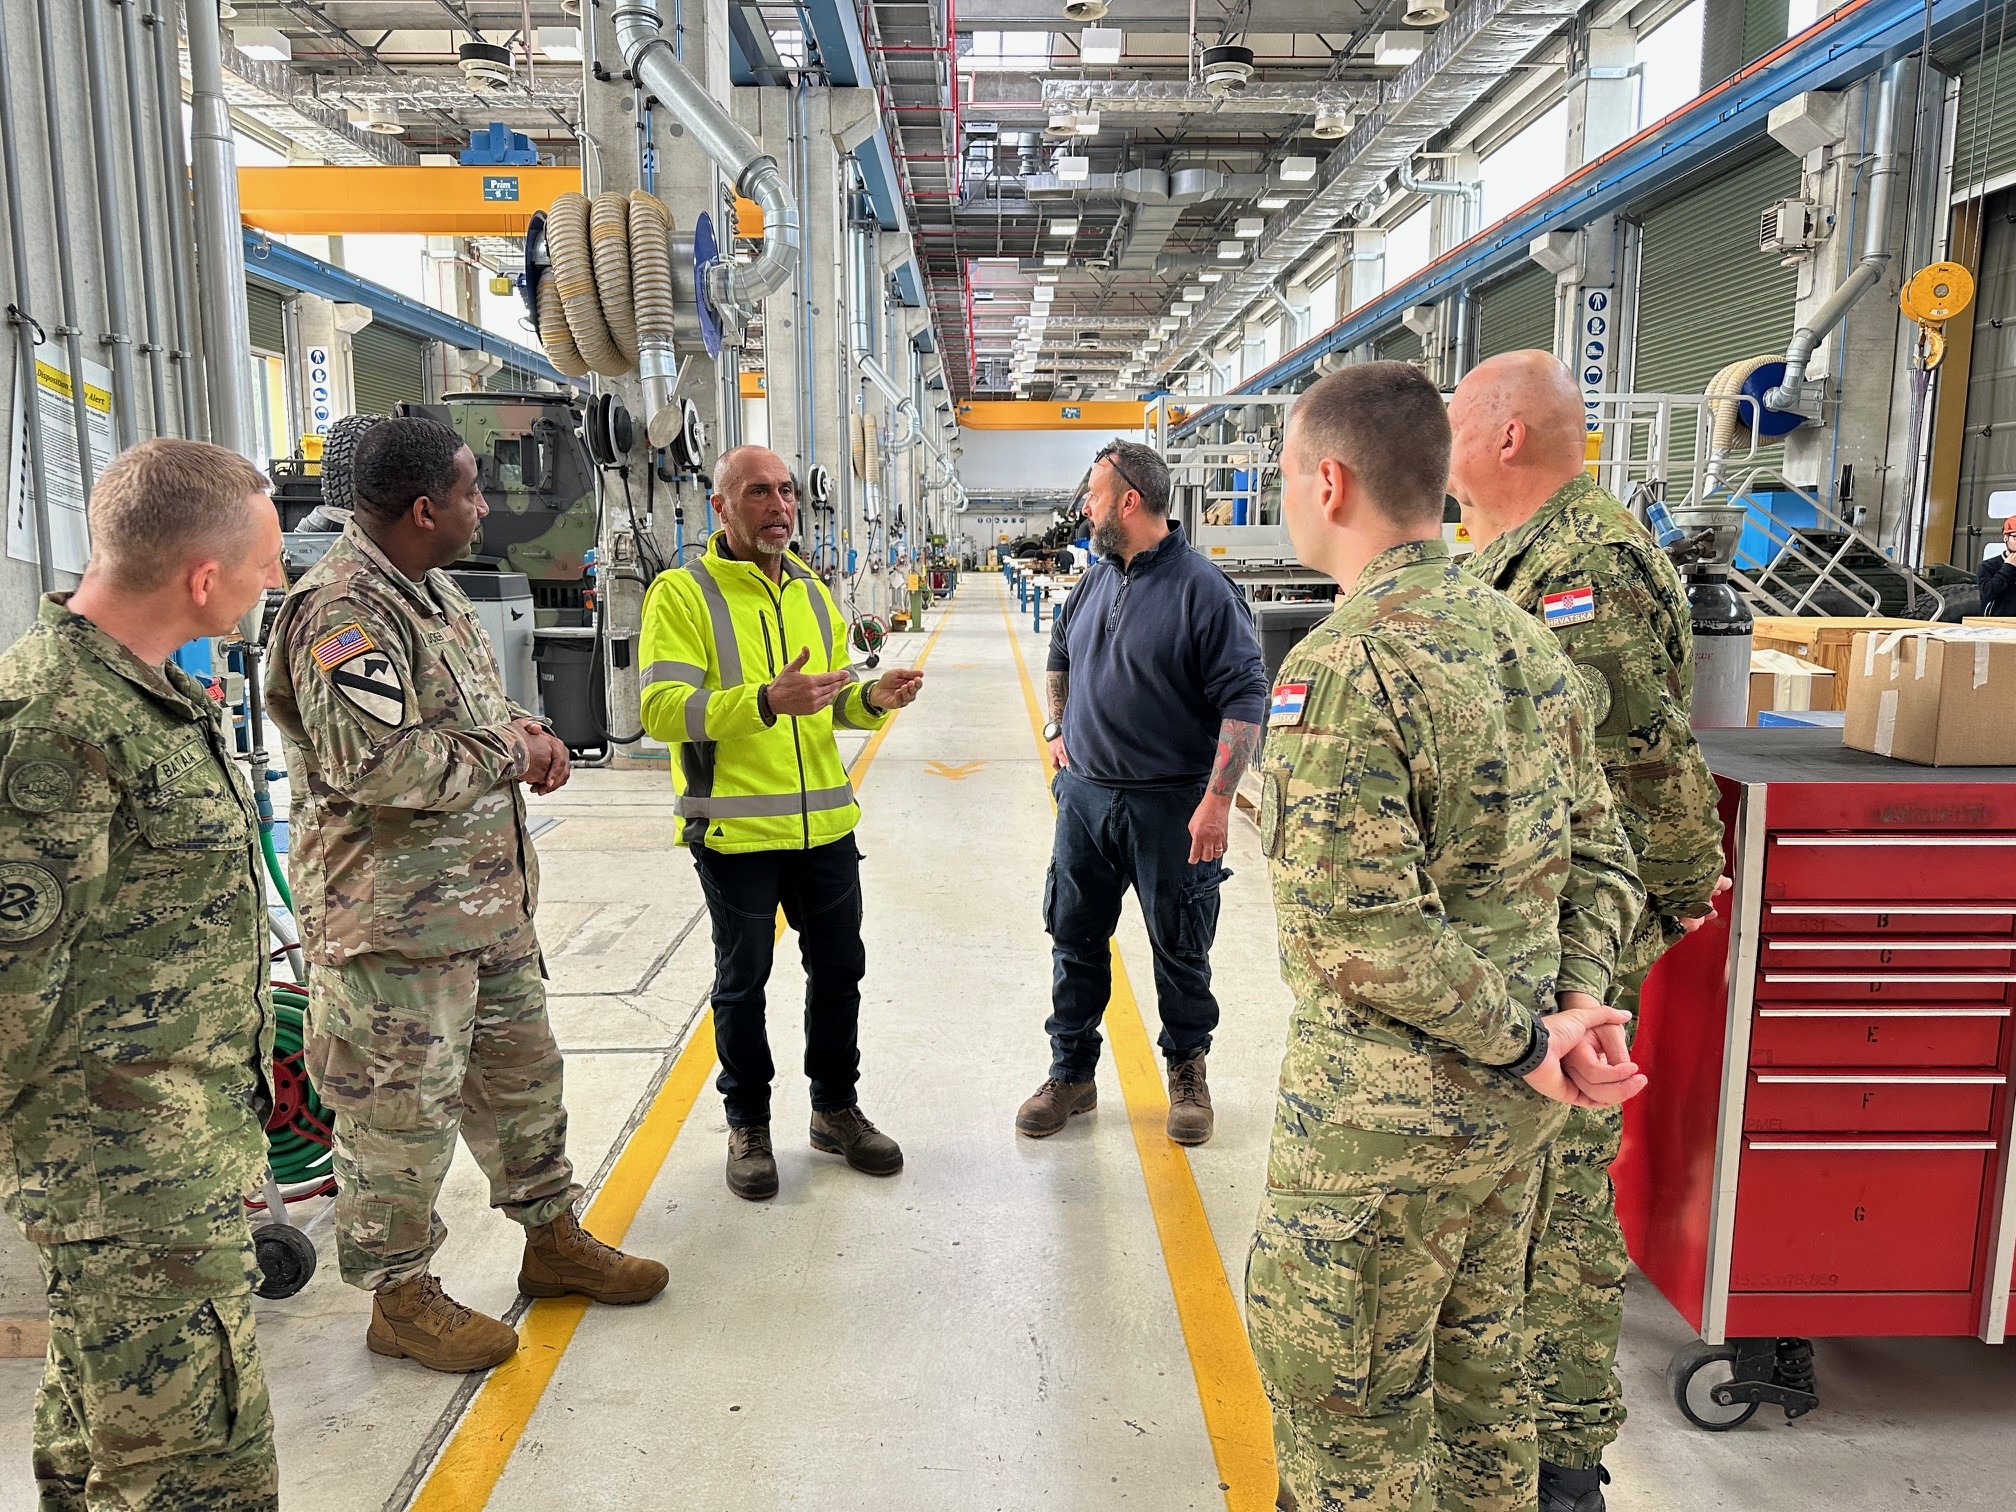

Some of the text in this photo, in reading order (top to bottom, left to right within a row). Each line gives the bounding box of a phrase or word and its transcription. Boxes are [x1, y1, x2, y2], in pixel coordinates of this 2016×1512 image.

[490, 179, 511, 189] Prim
[37, 369, 105, 405] Disposition Alert
[1547, 611, 1593, 627] HRVATSKA
[1877, 914, 1889, 928] B
[1880, 949, 1892, 963] C
[1866, 1025, 1879, 1043] E
[1862, 1092, 1875, 1109] F
[1853, 1206, 1866, 1222] G
